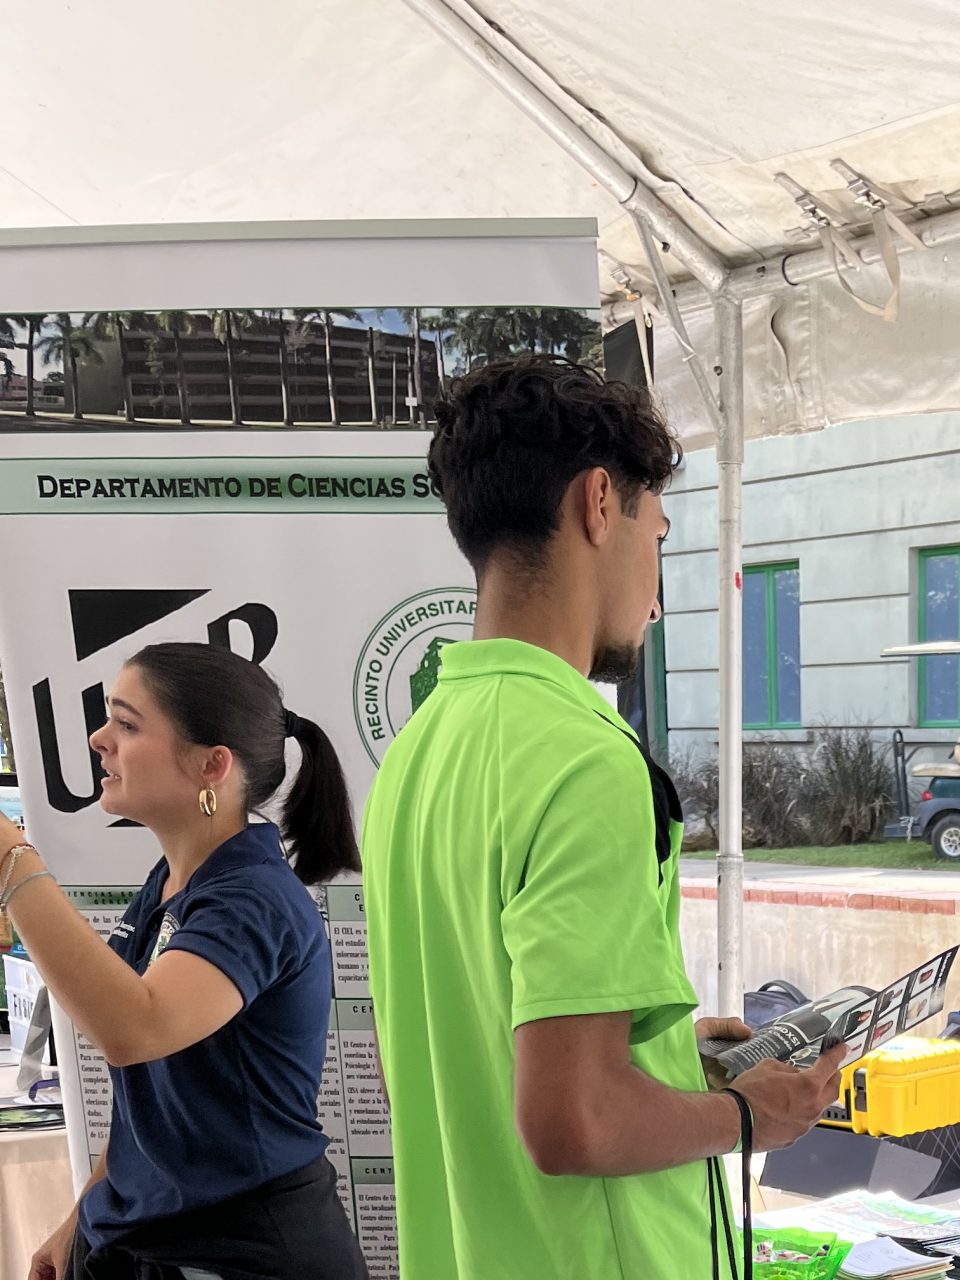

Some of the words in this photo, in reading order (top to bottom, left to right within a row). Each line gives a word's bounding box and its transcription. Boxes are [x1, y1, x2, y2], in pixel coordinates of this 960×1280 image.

[37, 474, 242, 498] DEPARTAMENTO
[249, 478, 283, 498] DE
[287, 474, 405, 499] CIENCIAS
[364, 659, 386, 740] RECINTO
